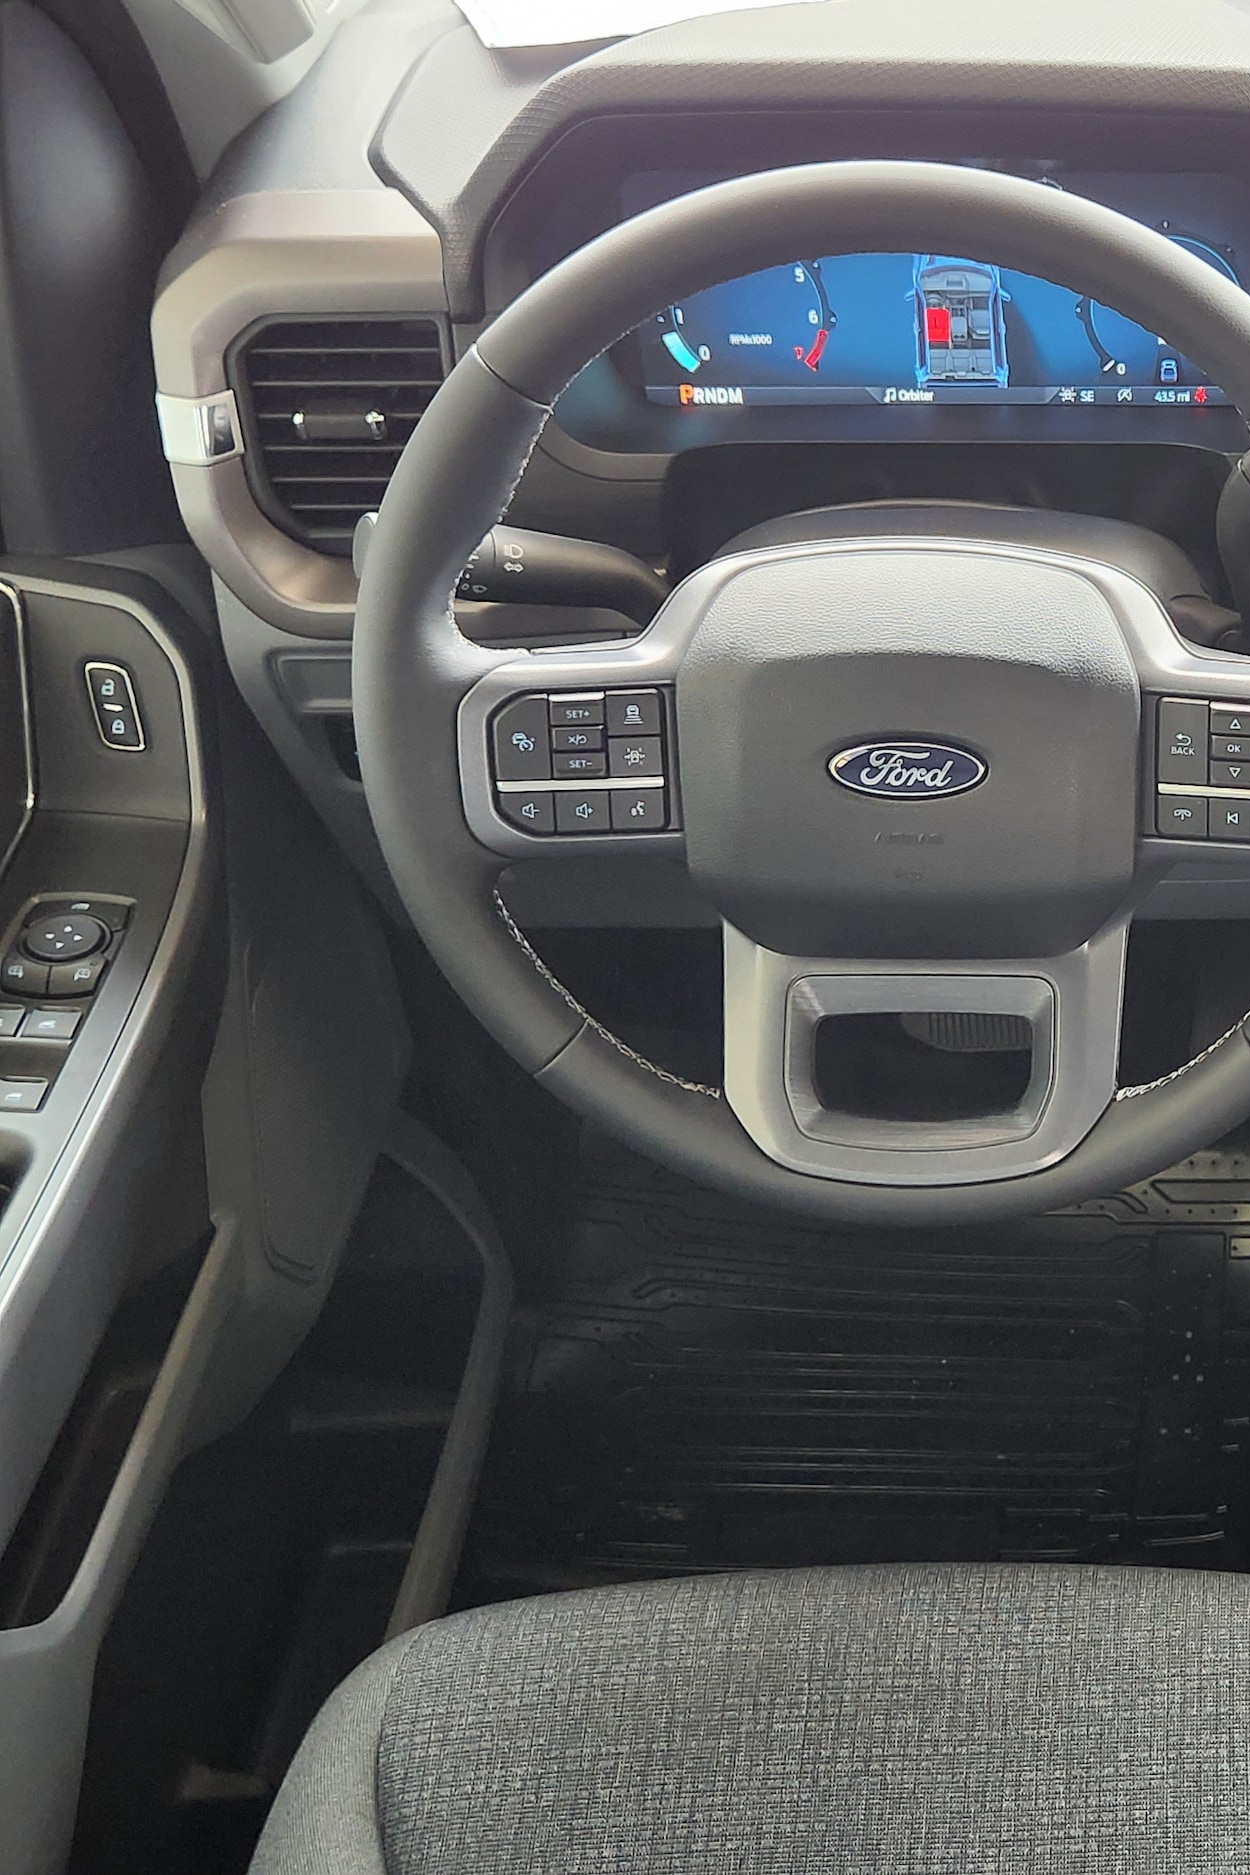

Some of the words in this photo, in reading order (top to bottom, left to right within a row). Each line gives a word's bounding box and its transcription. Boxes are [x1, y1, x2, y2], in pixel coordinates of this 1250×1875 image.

[795, 267, 804, 283] 5
[808, 309, 818, 324] 6
[699, 345, 711, 361] 0
[1116, 362, 1126, 375] 0
[898, 389, 934, 402] Orbiter
[1080, 389, 1095, 402] SE
[1154, 390, 1176, 403] 43.5
[1171, 746, 1196, 756] BACK
[1227, 743, 1241, 753] OK
[859, 749, 954, 788] Ford
